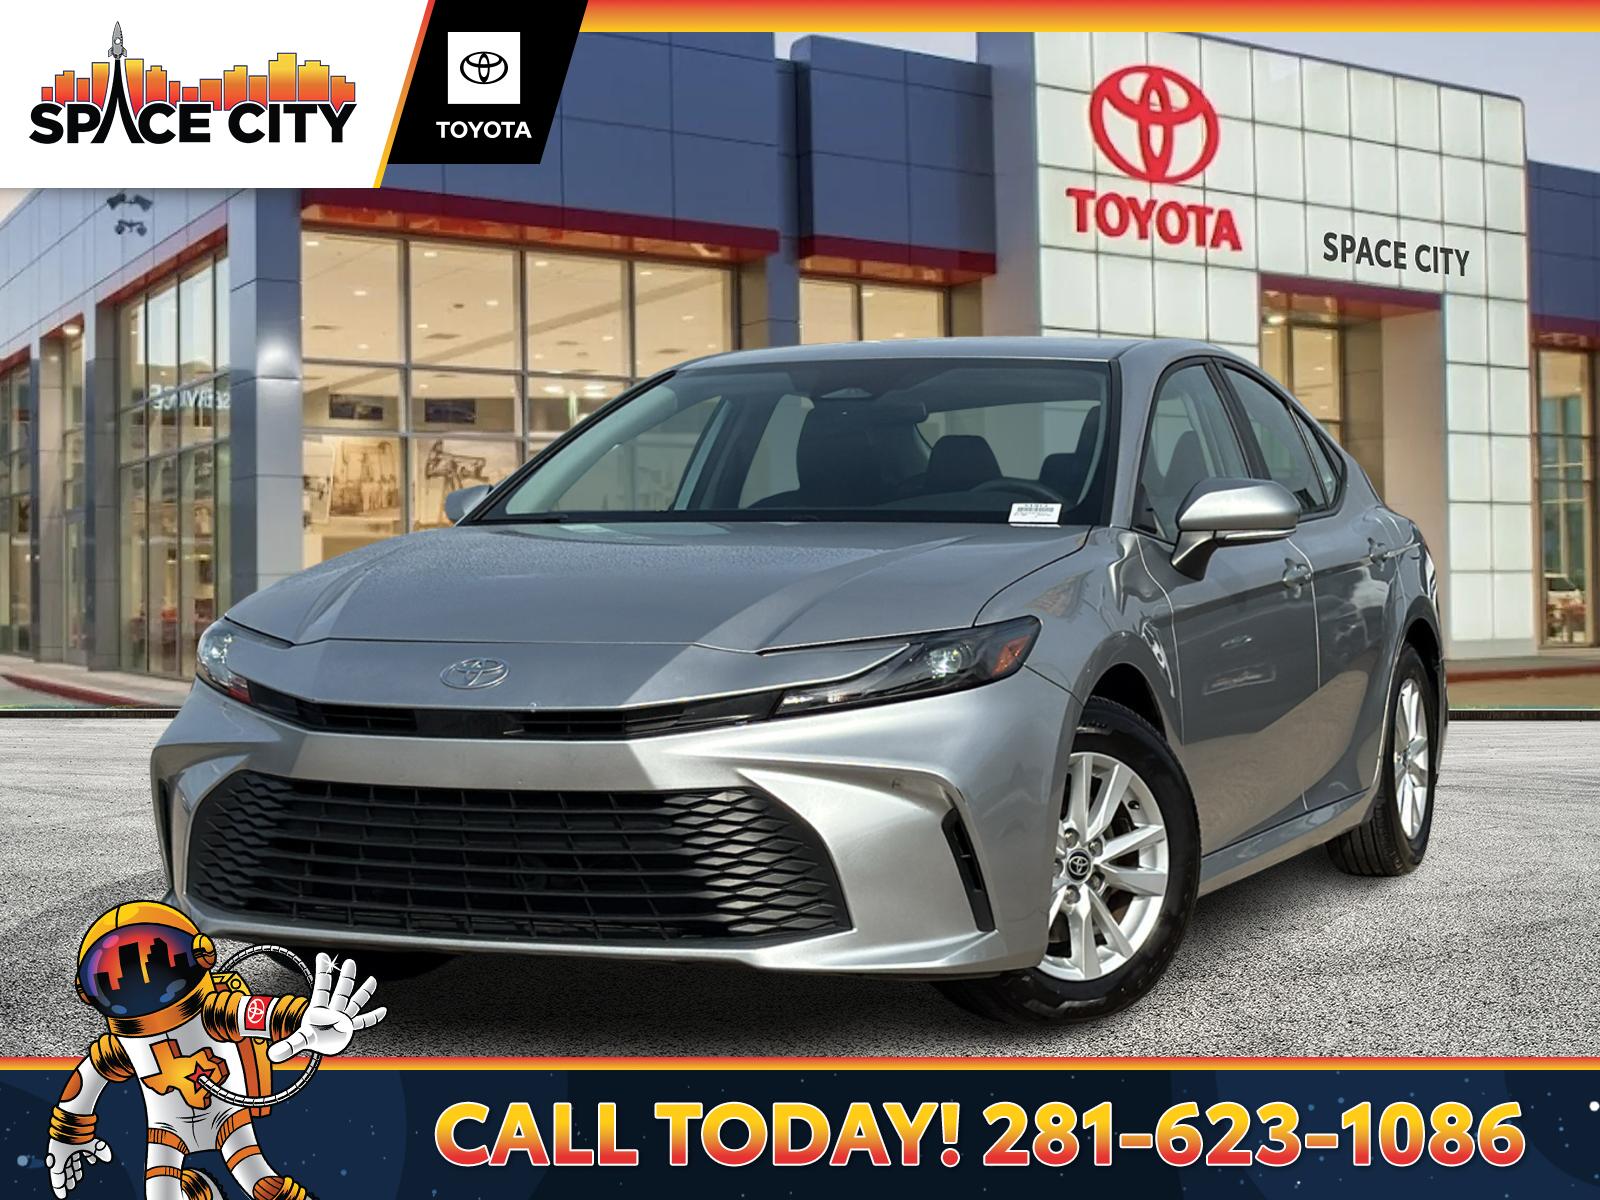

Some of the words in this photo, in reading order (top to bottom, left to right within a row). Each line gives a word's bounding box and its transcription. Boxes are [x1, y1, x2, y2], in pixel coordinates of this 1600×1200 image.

[1067, 187, 1242, 250] TOYOTA
[1323, 232, 1406, 270] SPACE
[1415, 244, 1470, 277] CITY
